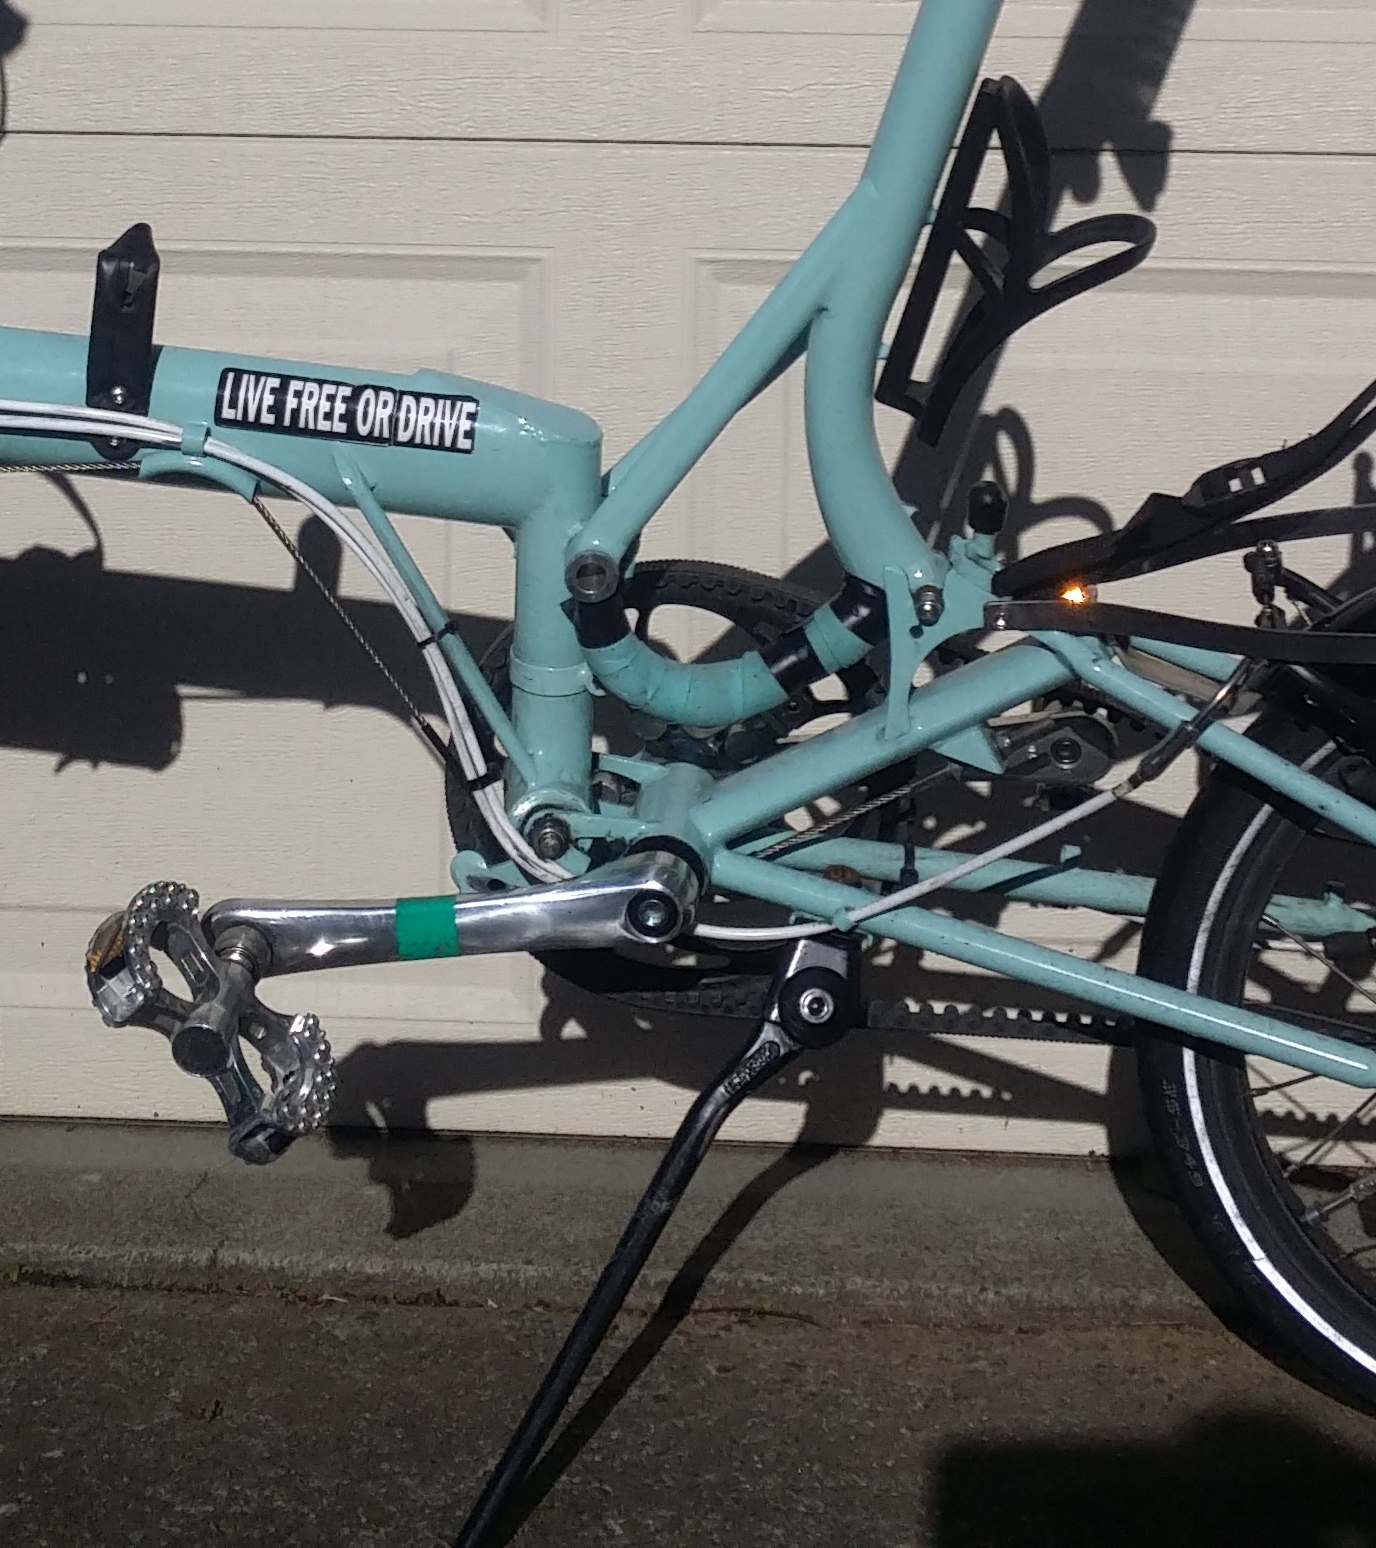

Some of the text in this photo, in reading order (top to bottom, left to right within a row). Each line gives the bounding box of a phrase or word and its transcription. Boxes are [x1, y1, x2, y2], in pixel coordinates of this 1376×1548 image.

[221, 371, 477, 450] LIVE FREE OR DRIVE
